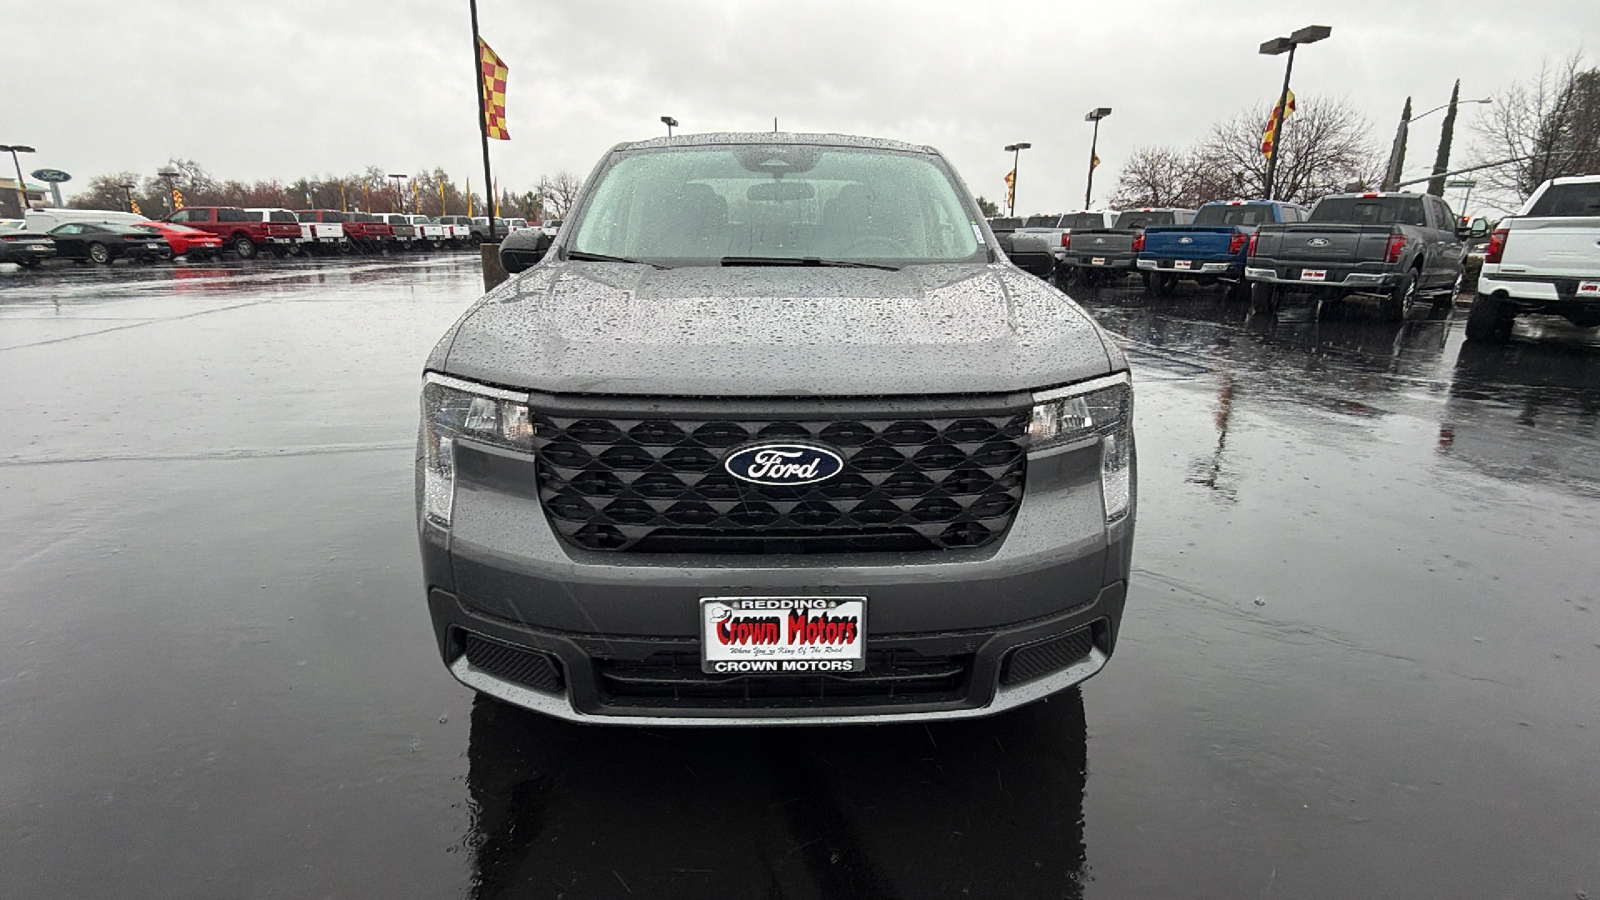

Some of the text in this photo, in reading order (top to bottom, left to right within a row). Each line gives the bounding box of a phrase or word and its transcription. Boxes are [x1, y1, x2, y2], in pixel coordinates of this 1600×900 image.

[41, 171, 64, 180] Ford
[748, 450, 820, 478] Ford
[741, 600, 827, 609] REDDING
[716, 609, 858, 646] Crown Motors
[753, 647, 776, 657] You're
[777, 647, 795, 655] King
[797, 647, 807, 655] Of
[809, 646, 821, 654] The
[715, 660, 853, 672] CROWN MOTORS
